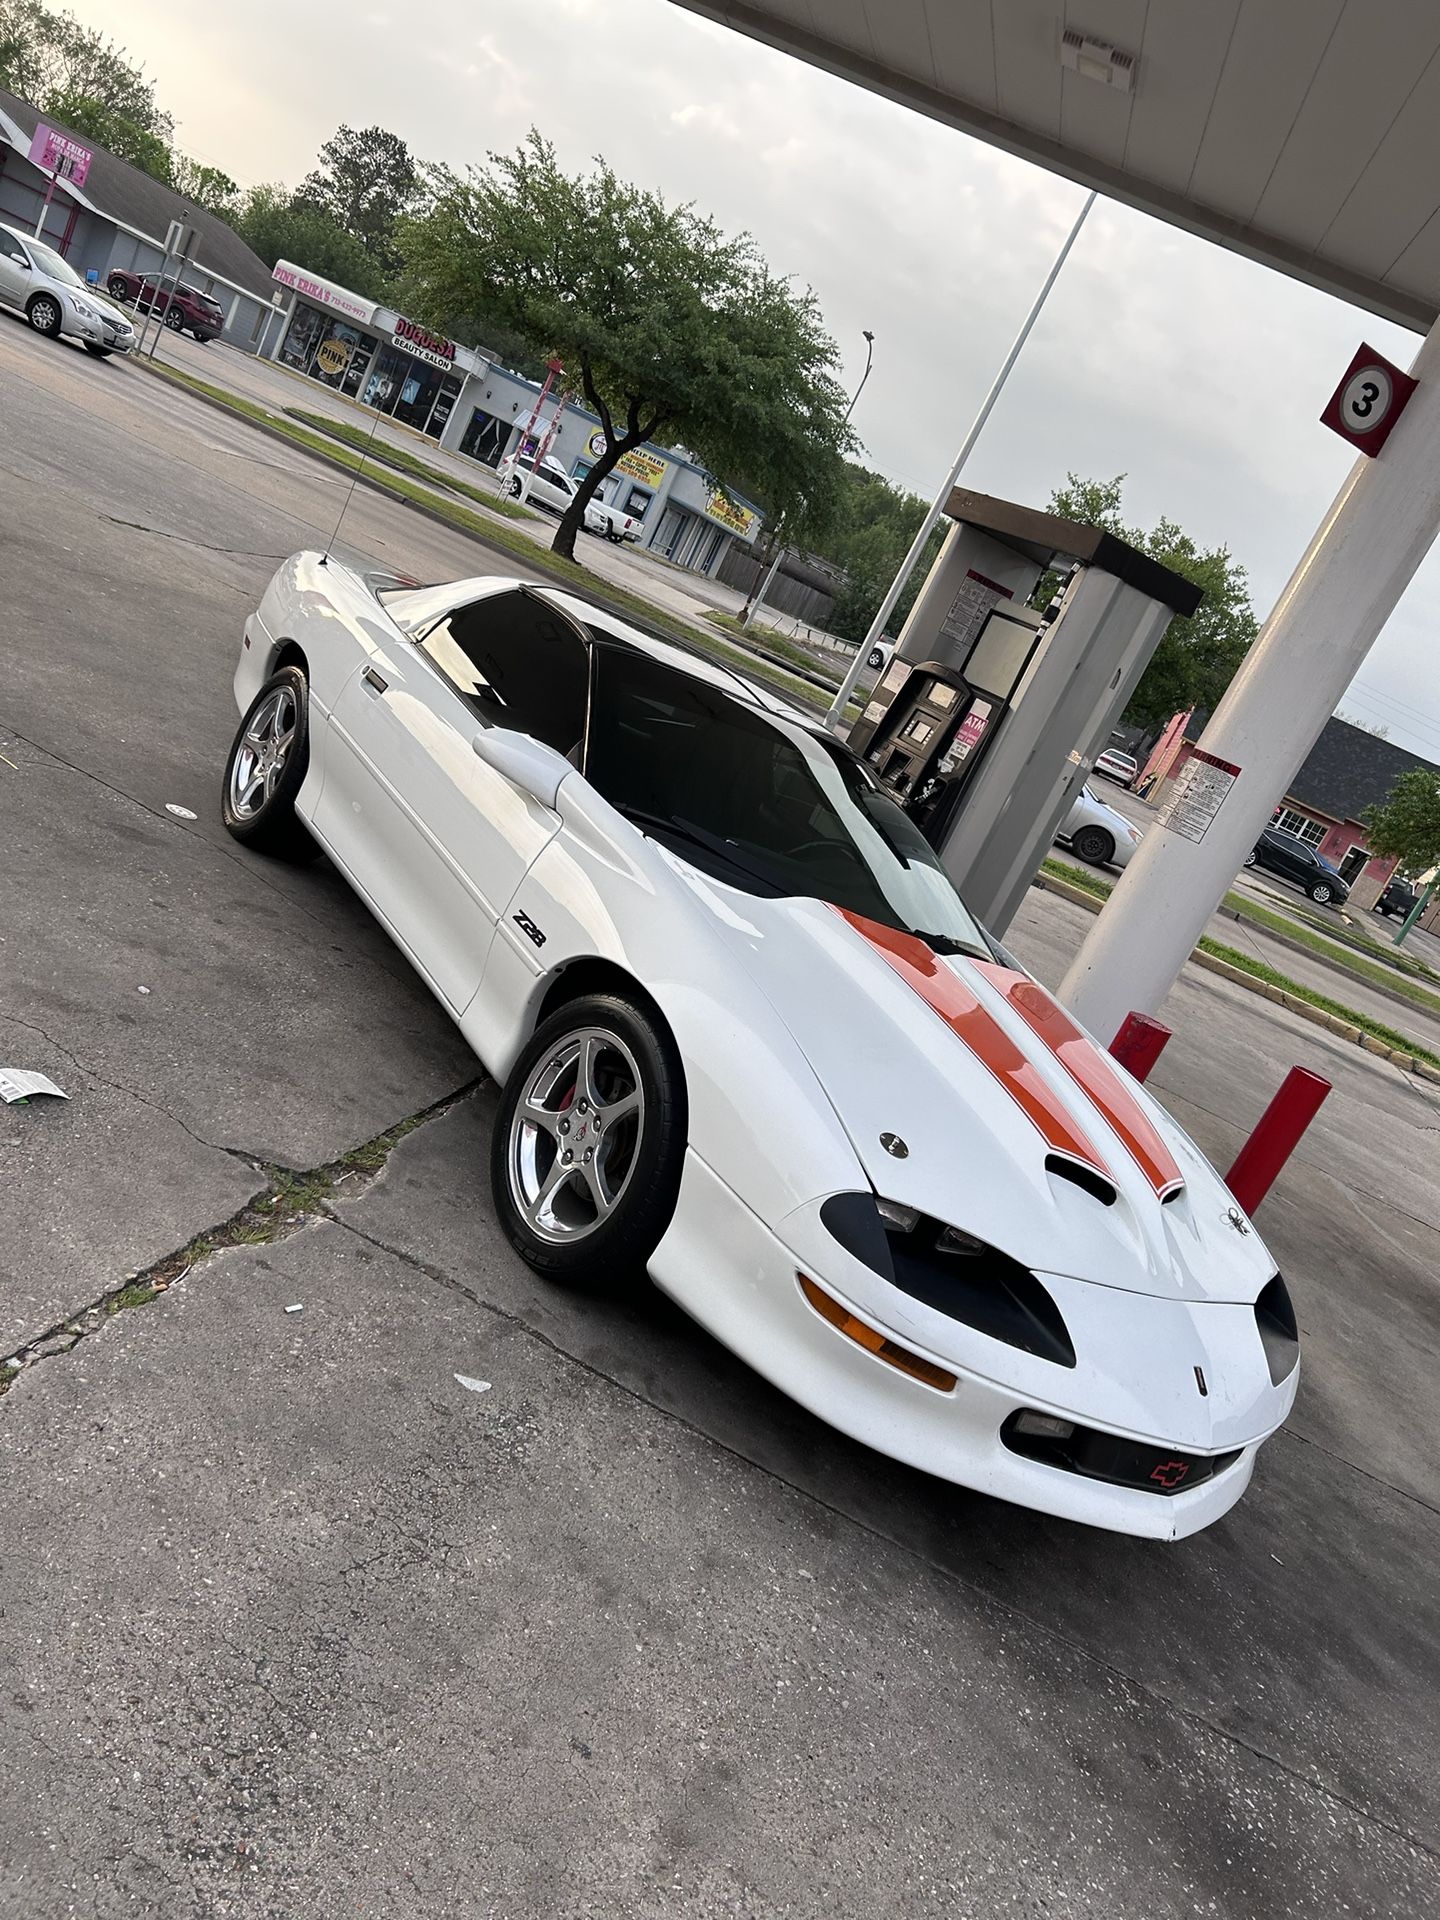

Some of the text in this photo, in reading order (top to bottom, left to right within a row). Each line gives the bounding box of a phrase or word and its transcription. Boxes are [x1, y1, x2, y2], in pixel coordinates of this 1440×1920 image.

[49, 132, 67, 148] PINK
[66, 141, 91, 161] ERIKA'S
[274, 267, 297, 286] PINK
[297, 276, 331, 302] ERIKA'S
[394, 318, 456, 361] DUQUESA
[394, 338, 450, 369] BEAUTY SALON
[321, 346, 344, 366] PINK
[1352, 382, 1380, 418] 3
[648, 456, 665, 467] HERE
[965, 715, 986, 731] ATM
[512, 909, 546, 948] Z28
